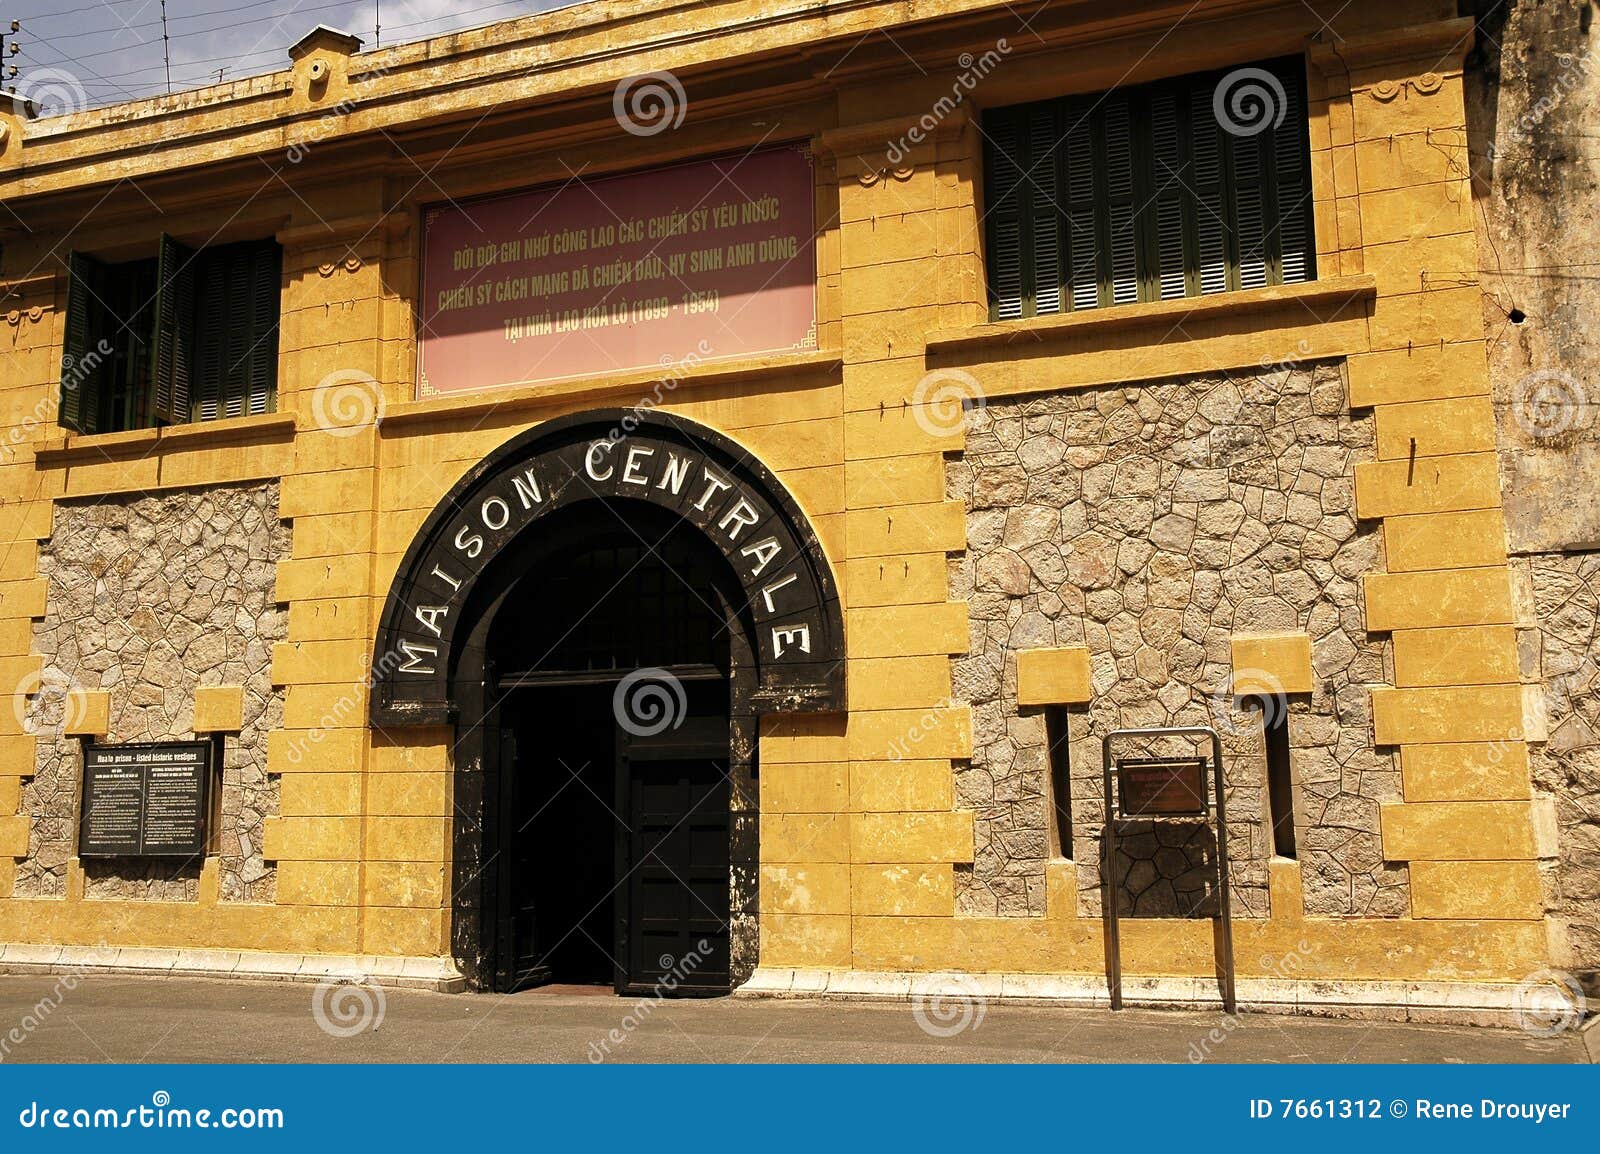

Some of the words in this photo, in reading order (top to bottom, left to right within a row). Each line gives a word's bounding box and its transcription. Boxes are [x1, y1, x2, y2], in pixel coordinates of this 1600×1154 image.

[501, 240, 521, 263] GHI
[524, 230, 550, 259] NHỚ
[553, 228, 587, 255] CÔNG
[591, 225, 614, 248] LAO
[618, 217, 644, 244] CÁC
[648, 206, 688, 239] CHIẾN
[712, 201, 738, 229] YÊU
[741, 193, 780, 225] NƯỚC
[438, 280, 474, 312] CHIẾN
[495, 274, 528, 302] CÁCH
[531, 274, 569, 300] MẠNG
[572, 265, 589, 291] ĐÃ
[593, 256, 632, 287] CHIẾN
[669, 253, 687, 277] HY
[690, 247, 723, 273] SINH
[727, 242, 755, 268] ANH
[759, 235, 798, 262] DŨNG
[504, 317, 523, 344] TẠI
[526, 309, 552, 337] NHÀ
[555, 309, 580, 333] LAO
[612, 297, 628, 326] LÒ
[631, 297, 669, 326] (1899
[682, 289, 720, 315] 1954)
[398, 467, 544, 674] MAISON
[584, 438, 811, 660] CENTRALE
[152, 752, 173, 762] historic
[173, 751, 197, 762] vestiges
